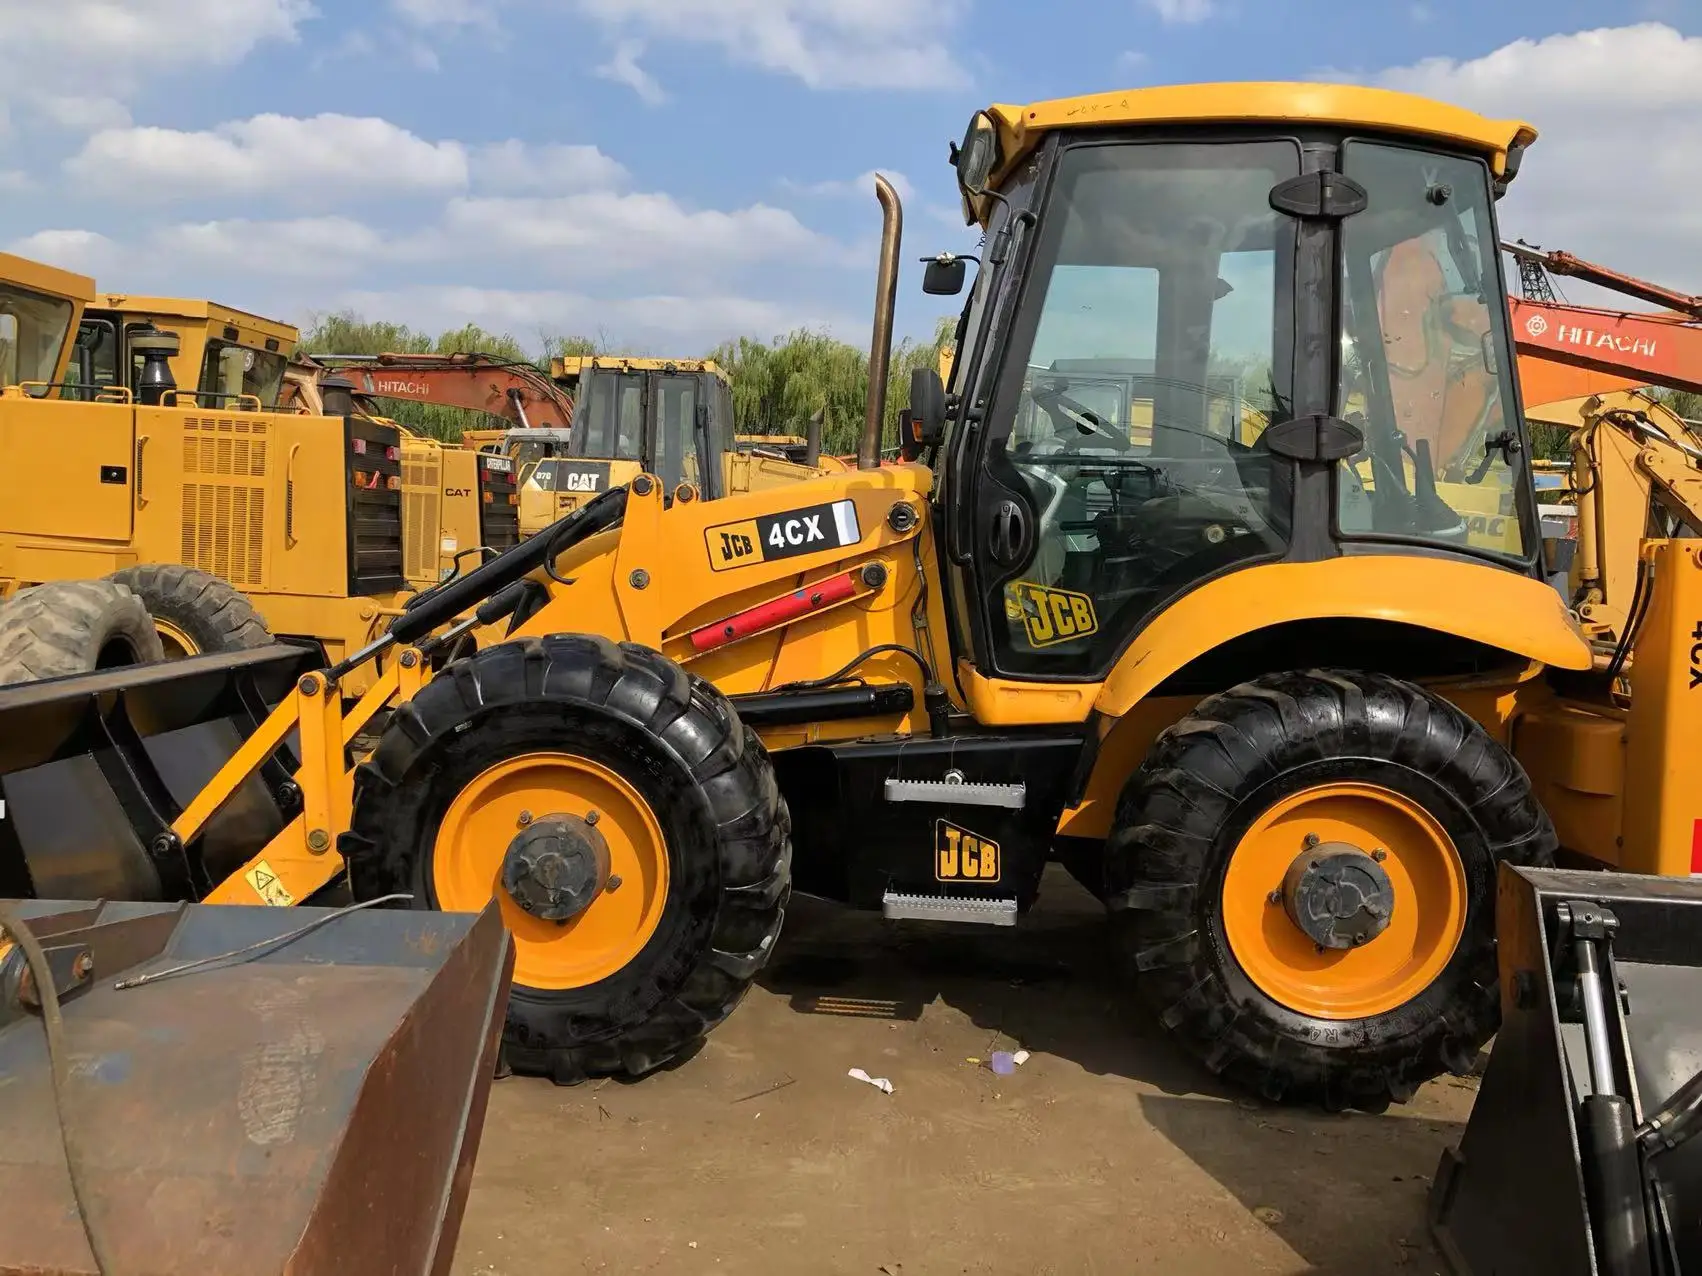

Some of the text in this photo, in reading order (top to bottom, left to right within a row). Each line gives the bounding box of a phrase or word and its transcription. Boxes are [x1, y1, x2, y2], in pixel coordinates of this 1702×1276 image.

[1557, 324, 1657, 357] HITACHI
[378, 380, 430, 395] HITACHI
[445, 488, 471, 497] CAT
[567, 472, 600, 492] CAT
[720, 514, 825, 561] JCB 4CX
[1029, 589, 1093, 640] JCB
[940, 826, 996, 878] JCB
